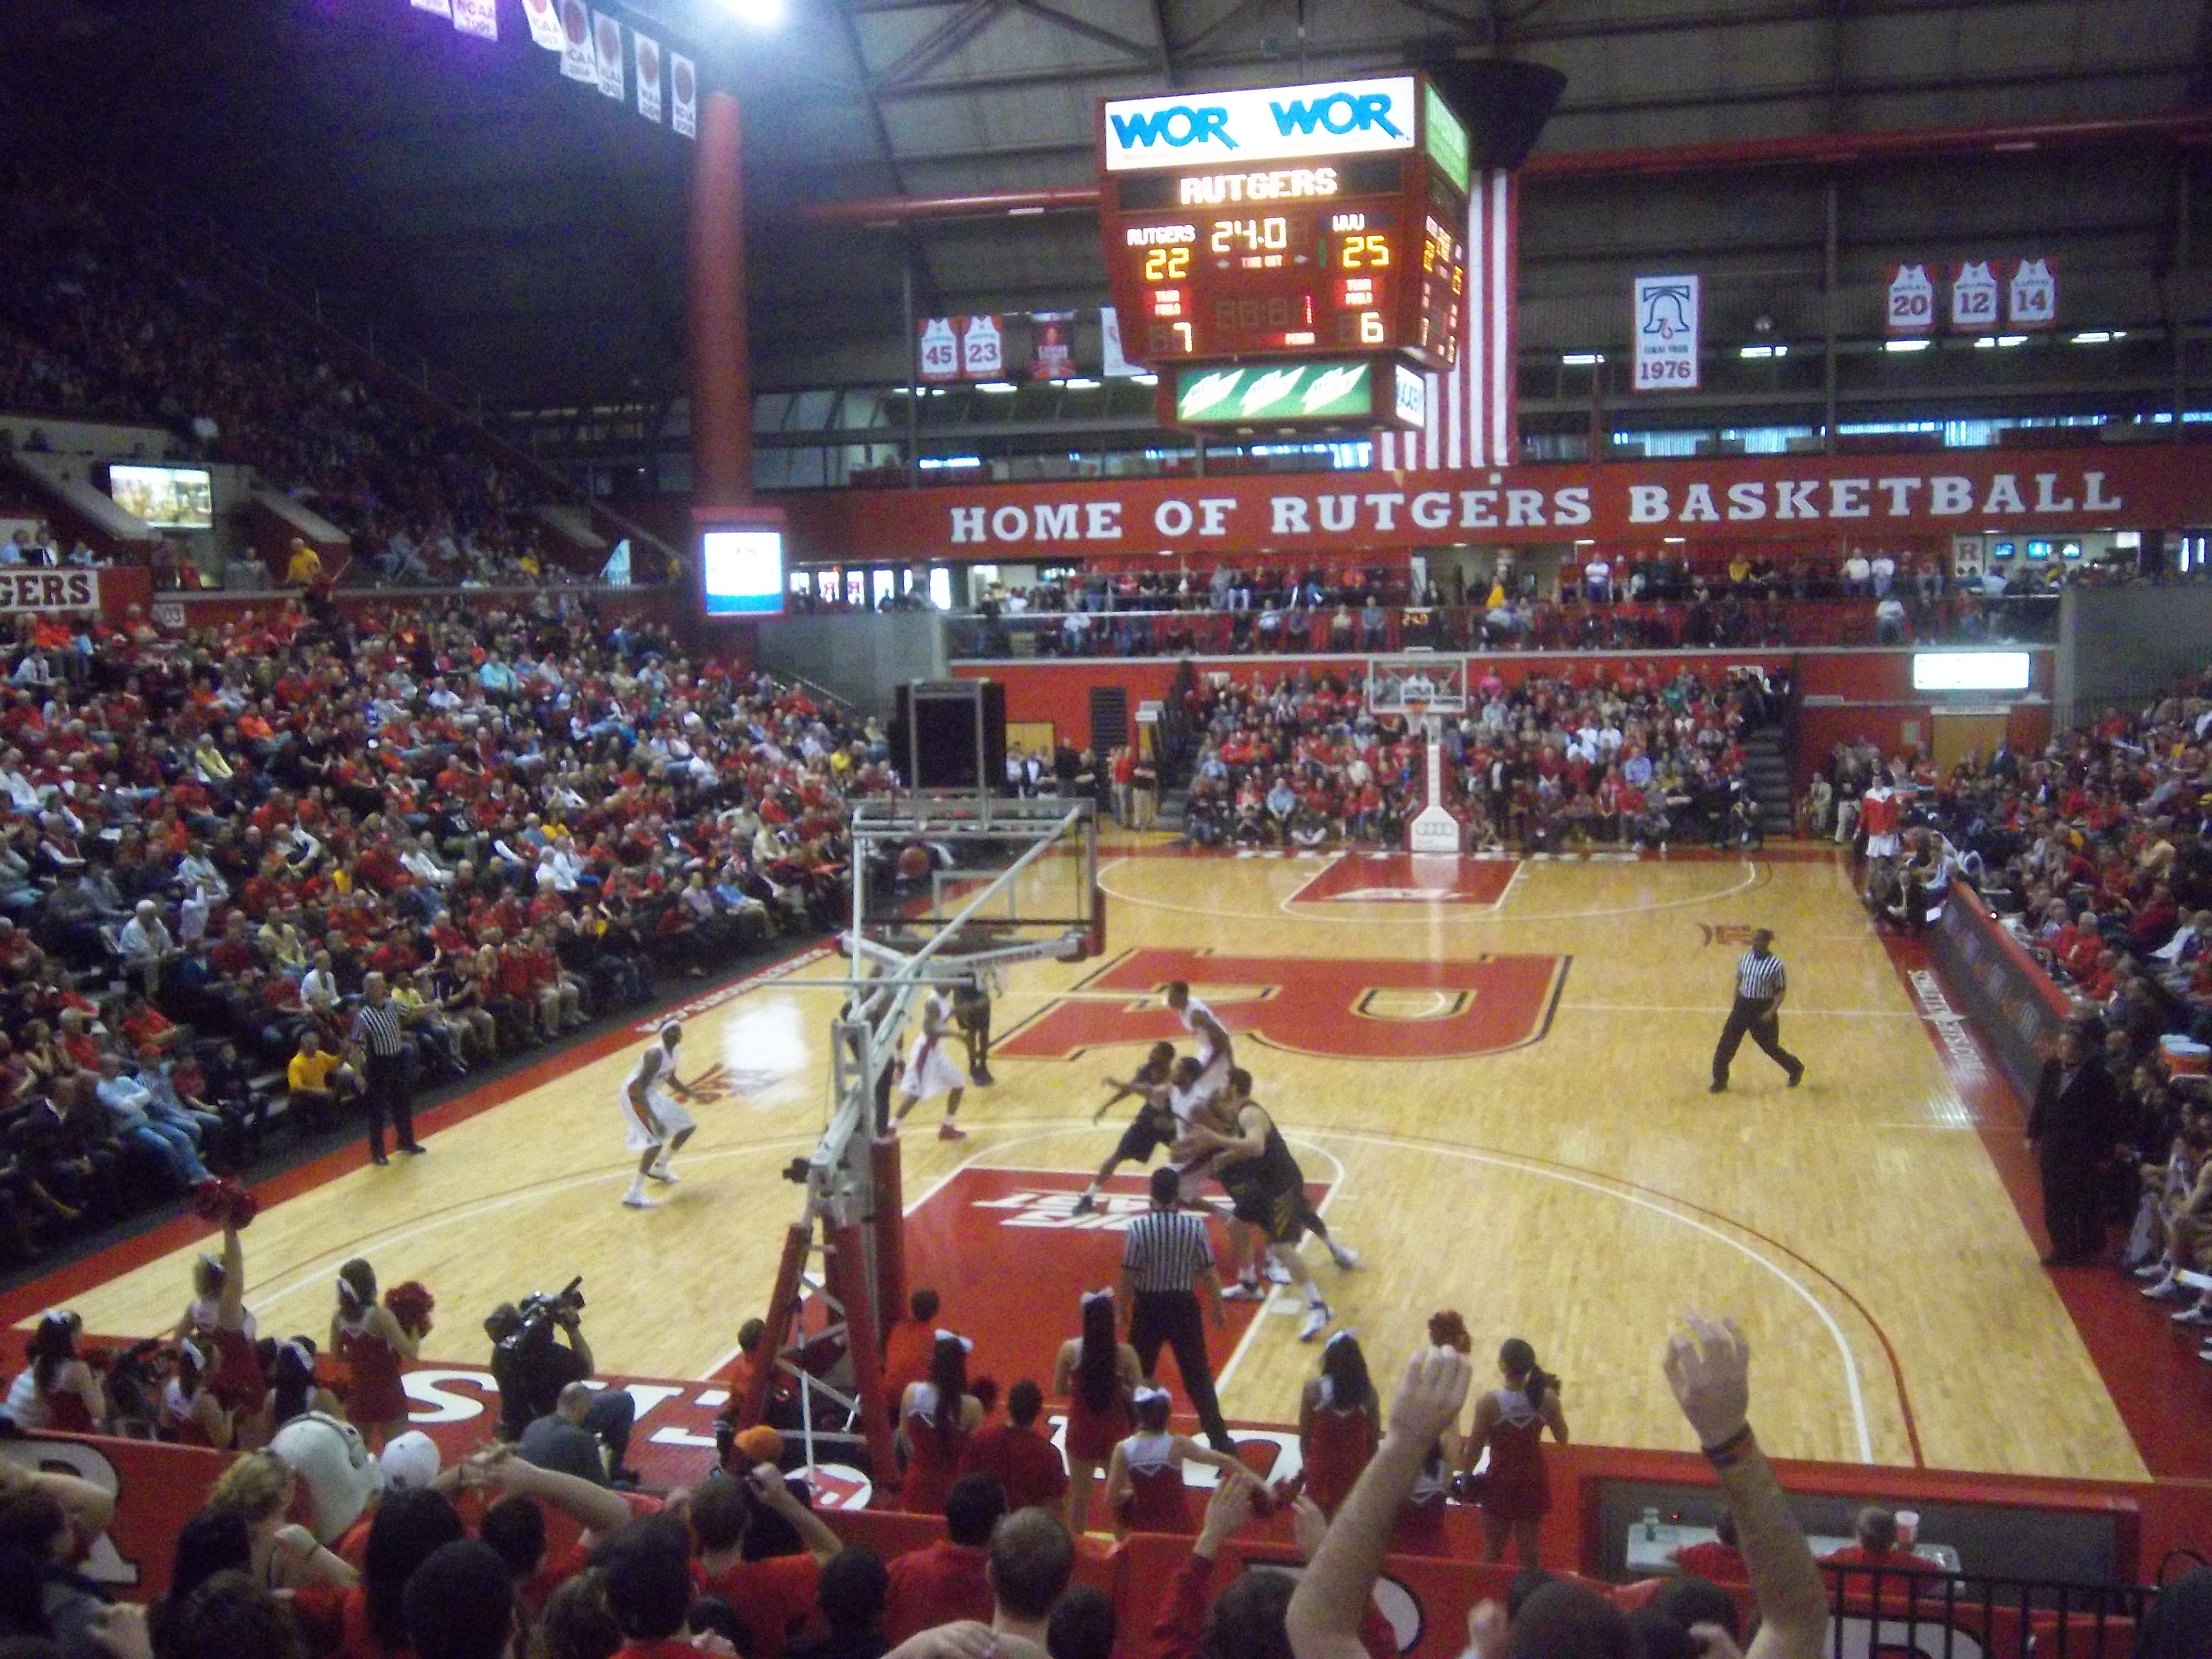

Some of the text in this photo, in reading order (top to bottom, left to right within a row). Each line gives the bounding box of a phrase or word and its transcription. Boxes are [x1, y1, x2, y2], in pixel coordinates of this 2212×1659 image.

[1110, 92, 1405, 151] WOR WOR
[1181, 168, 1338, 205] RUTGERS
[1127, 225, 1196, 246] RUTGERS
[1145, 247, 1190, 280] 22
[1343, 235, 1390, 268] 25
[1893, 294, 1928, 316] 20
[1960, 292, 1990, 314] 12
[2016, 288, 2046, 312] 14
[1360, 311, 1384, 343] 6
[925, 345, 952, 365] 45
[968, 343, 997, 363] 23
[1641, 360, 1691, 381] 1976
[950, 471, 2122, 543] HOME OF RUTGERS BASKETBALL
